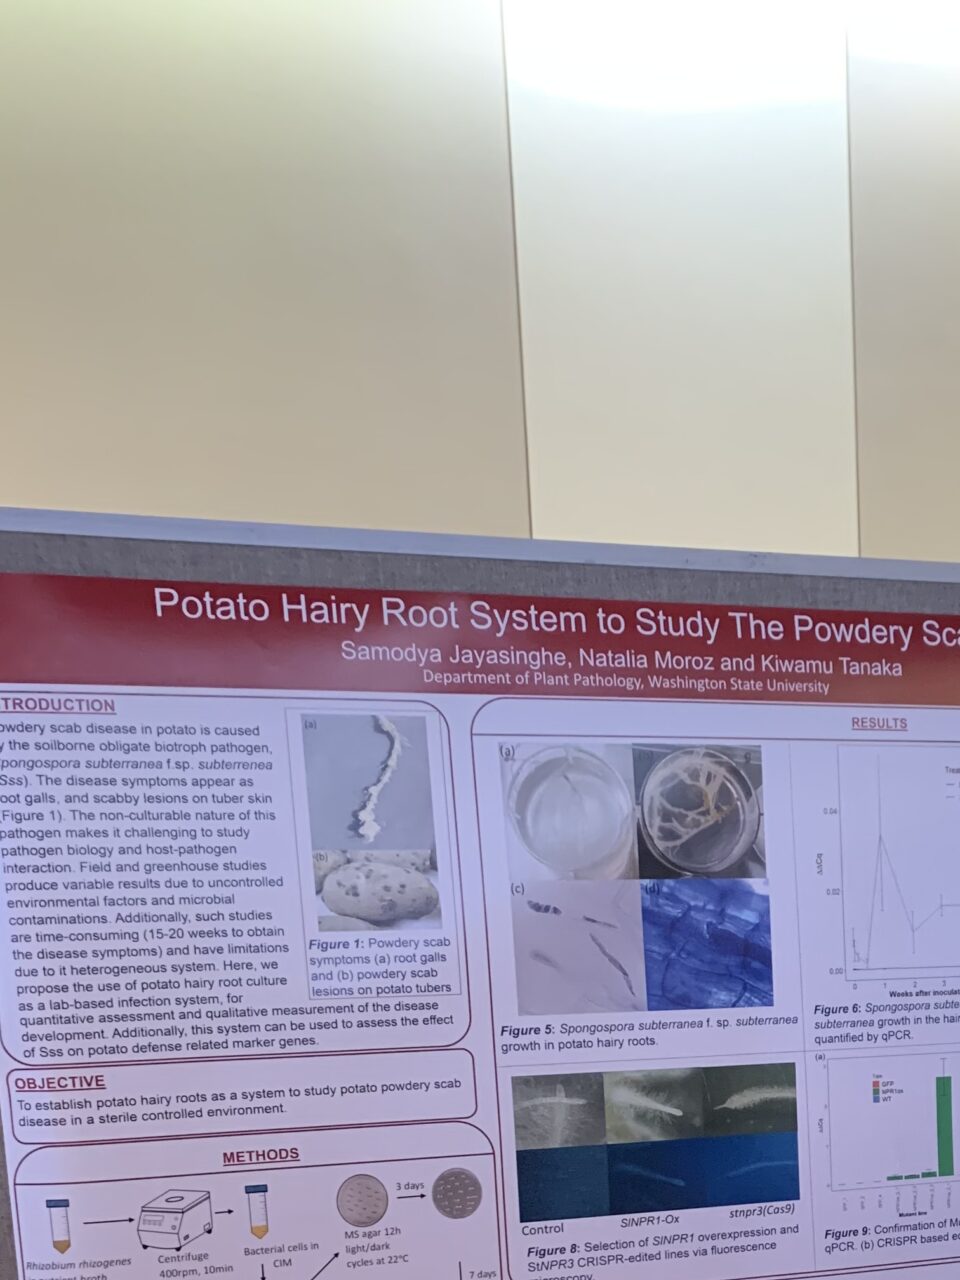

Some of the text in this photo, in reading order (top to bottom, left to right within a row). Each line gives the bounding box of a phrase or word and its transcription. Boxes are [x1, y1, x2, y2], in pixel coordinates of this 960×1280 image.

[154, 587, 269, 621] Potato
[281, 592, 369, 633] Hairy
[381, 596, 460, 633] Root
[469, 600, 586, 638] System
[596, 607, 625, 634] to
[635, 607, 719, 645] Study
[727, 611, 784, 640] The
[793, 614, 913, 652] Powdery
[341, 641, 902, 676] Samodya Jayasinghe, Natalia Moroz and Kiwamu Tanaka
[422, 668, 829, 695] Department of Plant Pathology, Washington State University
[0, 697, 115, 712] TRODUCTION
[852, 716, 908, 730] RESULTS
[4, 875, 283, 893] produce variable results due to uncontrolled
[6, 893, 235, 908] environmental factors and microbial
[8, 909, 272, 926] contaminations. Additionally, such studies
[309, 936, 451, 952] Figure 1: Powdery scab
[309, 951, 447, 967] symptoms (a) root galls
[311, 967, 438, 982] and (b) powdery scab
[312, 982, 452, 998] lesions on potato tubers
[500, 1025, 541, 1039] Figure
[544, 1023, 555, 1035] 5:
[559, 1022, 634, 1036] Spongospora
[638, 1020, 703, 1031] subterranea
[735, 1015, 798, 1026] subterranea
[814, 1032, 864, 1046] quantified
[866, 1031, 879, 1044] by
[14, 1074, 106, 1090] OBJECTIVE
[16, 1078, 461, 1111] To establish potato hairy roots as a system to study potato powdery scab
[18, 1103, 286, 1127] disease in a sterile controlled environment.
[223, 1147, 300, 1165] METHODS
[521, 1223, 564, 1236] Control
[526, 1246, 566, 1259] Figure
[569, 1243, 580, 1254] 8:
[583, 1239, 635, 1252] Selection
[652, 1232, 694, 1246] SlNPR1
[697, 1227, 776, 1242] overexpression
[779, 1223, 799, 1234] and
